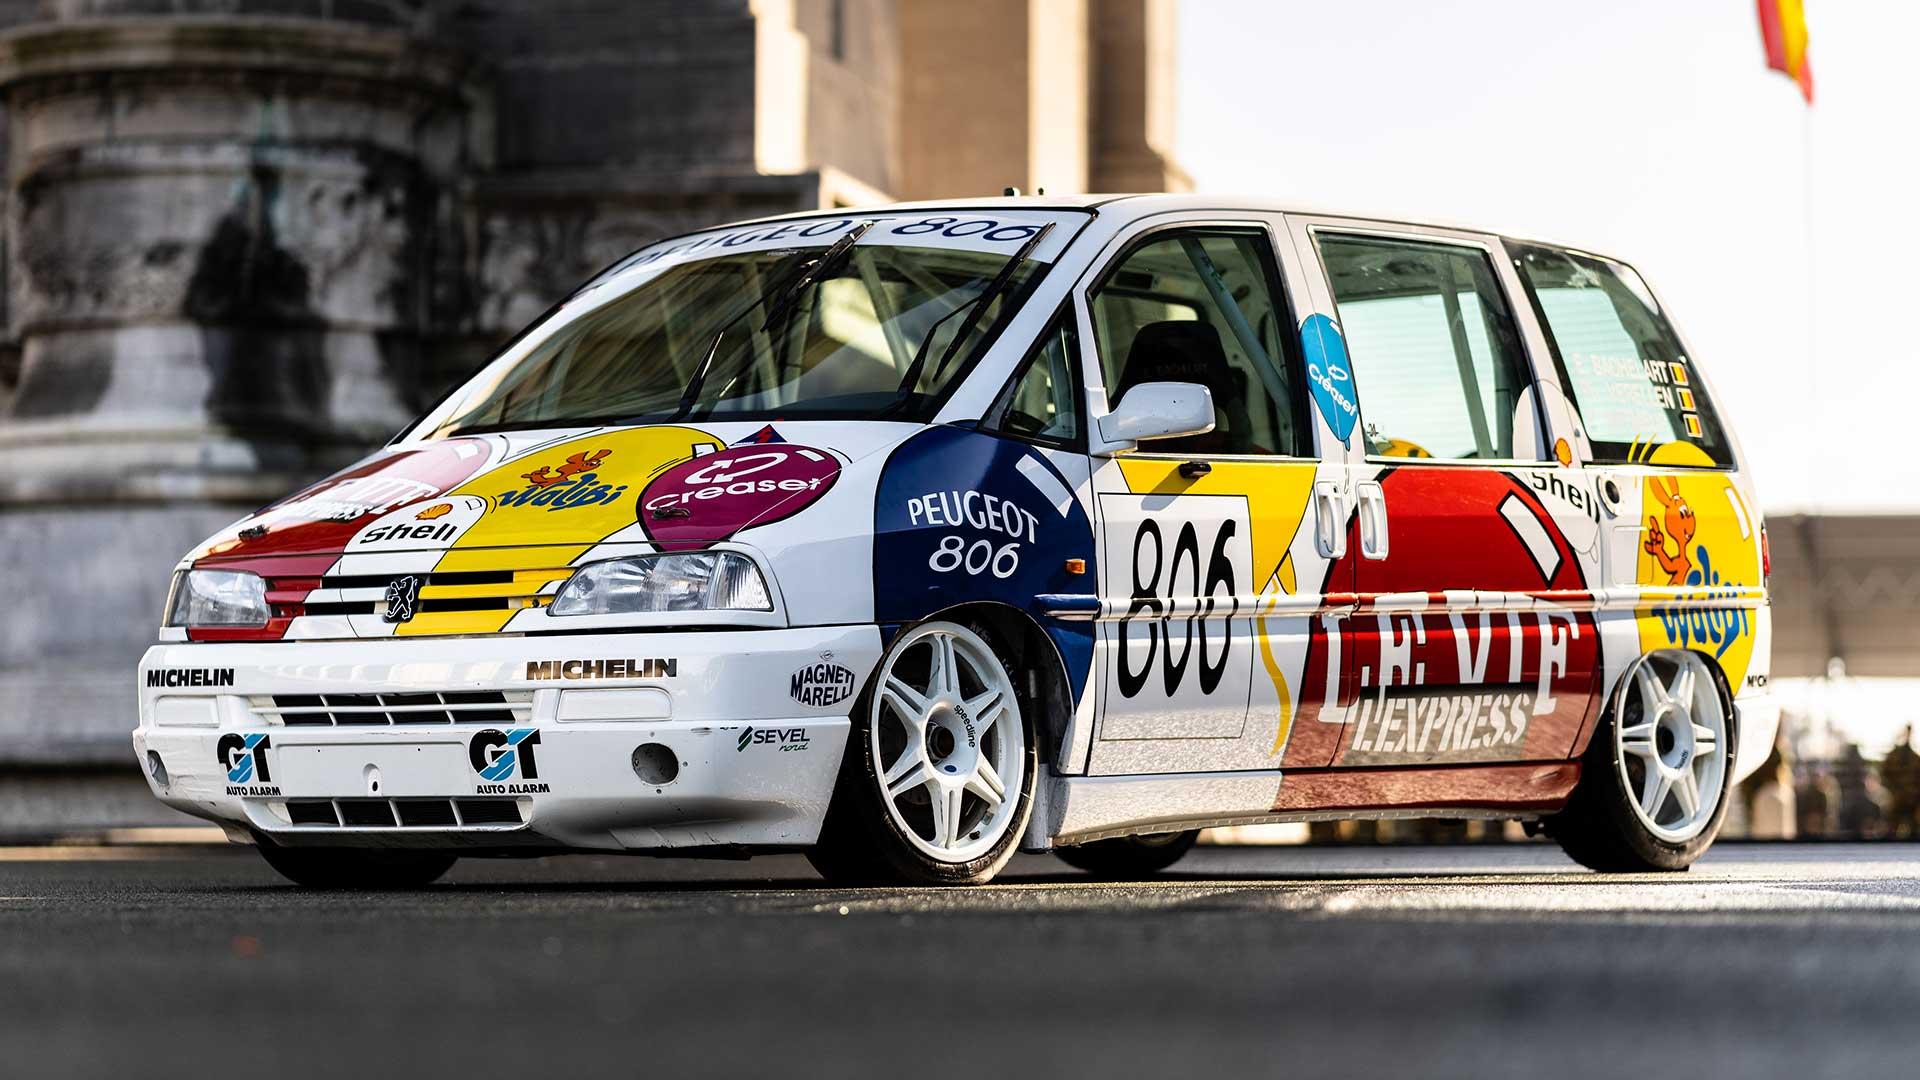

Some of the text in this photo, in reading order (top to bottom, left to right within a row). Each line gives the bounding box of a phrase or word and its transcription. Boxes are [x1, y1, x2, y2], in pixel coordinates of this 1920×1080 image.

[891, 217, 1044, 242] 806
[1531, 472, 1600, 524] Shell
[359, 523, 458, 544] Shell
[907, 490, 1040, 544] PEUGEOT
[928, 535, 1021, 579] 806
[1117, 518, 1238, 699] 806
[146, 668, 235, 687] MICHELIN
[526, 658, 678, 681] MICHELIN
[791, 664, 855, 692] MAGNETI
[753, 728, 811, 744] SEVEL
[953, 704, 976, 748] speedline
[1351, 693, 1531, 753] L'EXPRESS
[216, 732, 272, 784] GT
[468, 728, 542, 782] GT
[226, 786, 282, 796] AUTO ALARM
[476, 783, 551, 795] AUTO ALARM
